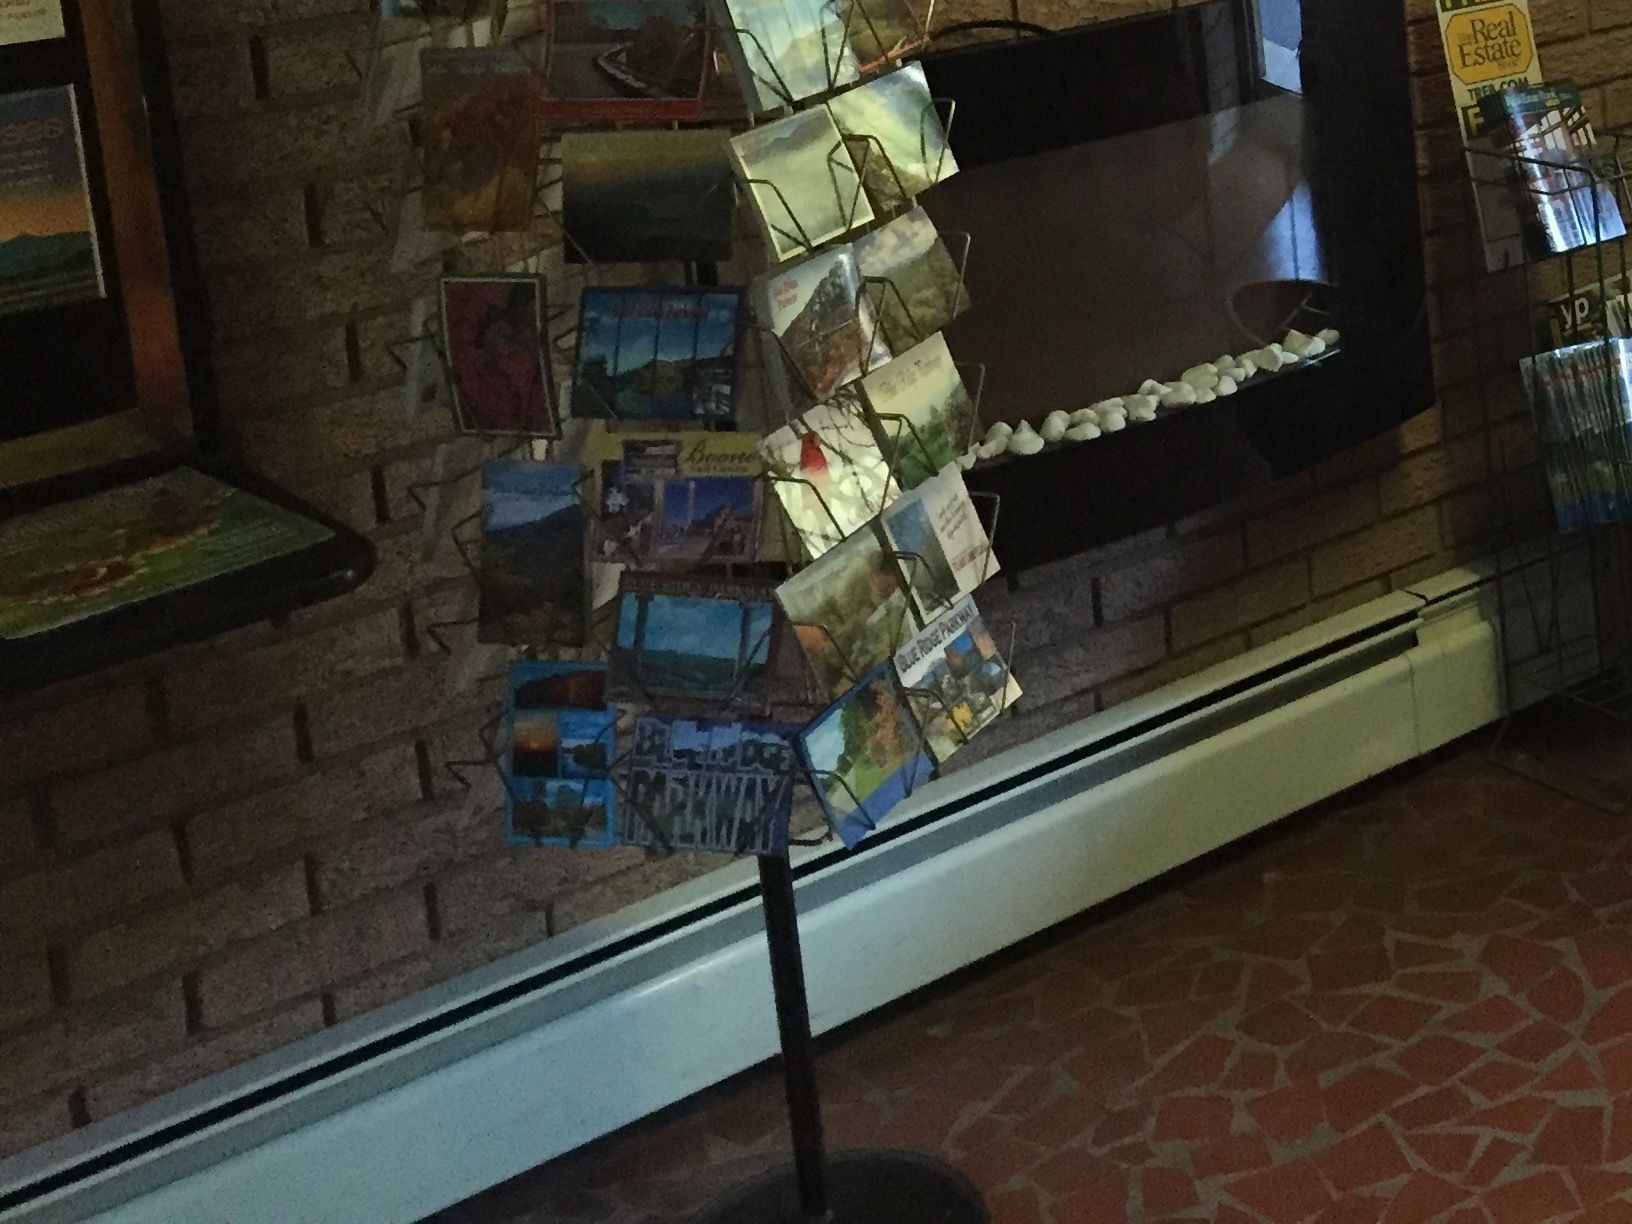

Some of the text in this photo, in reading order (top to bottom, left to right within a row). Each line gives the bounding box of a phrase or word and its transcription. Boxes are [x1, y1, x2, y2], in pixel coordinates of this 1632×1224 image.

[1471, 11, 1517, 44] Real
[1458, 38, 1522, 69] Estate
[684, 438, 757, 463] Boone
[898, 651, 921, 674] BLUE
[916, 633, 939, 658] RIDGE
